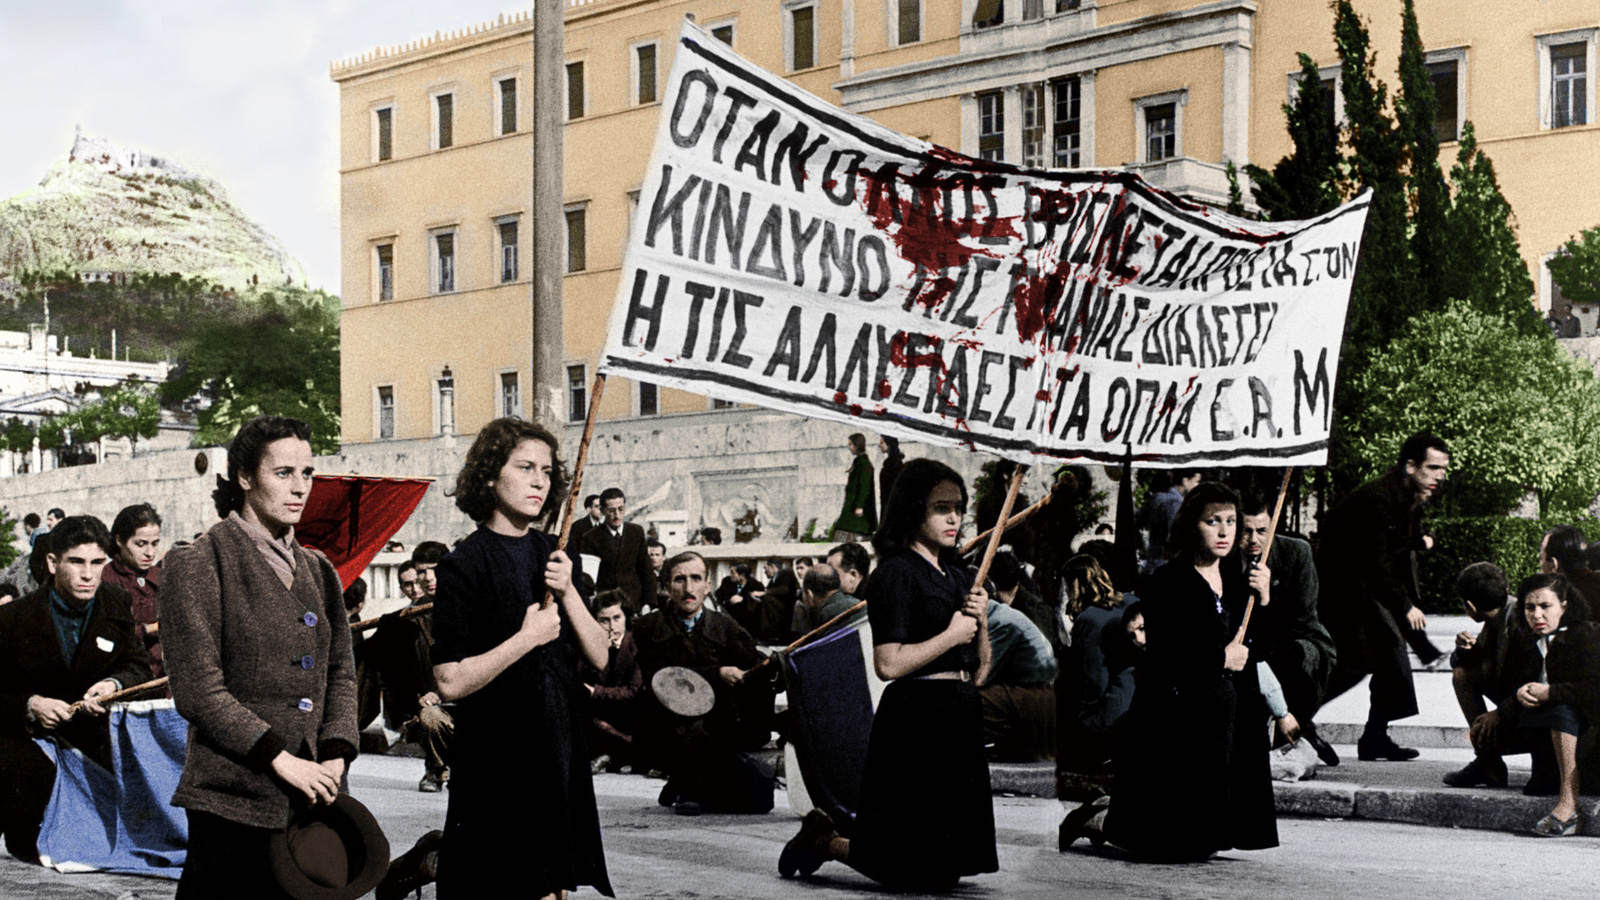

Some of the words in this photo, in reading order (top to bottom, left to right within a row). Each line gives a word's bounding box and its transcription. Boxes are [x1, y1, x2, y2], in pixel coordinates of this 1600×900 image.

[670, 69, 829, 192] ΟΤΑΝ
[822, 150, 867, 206] Ο
[645, 164, 891, 301] ΚΙΝΔΥΝΟ
[622, 268, 670, 351] Η
[681, 281, 764, 368] ΤΙΣ
